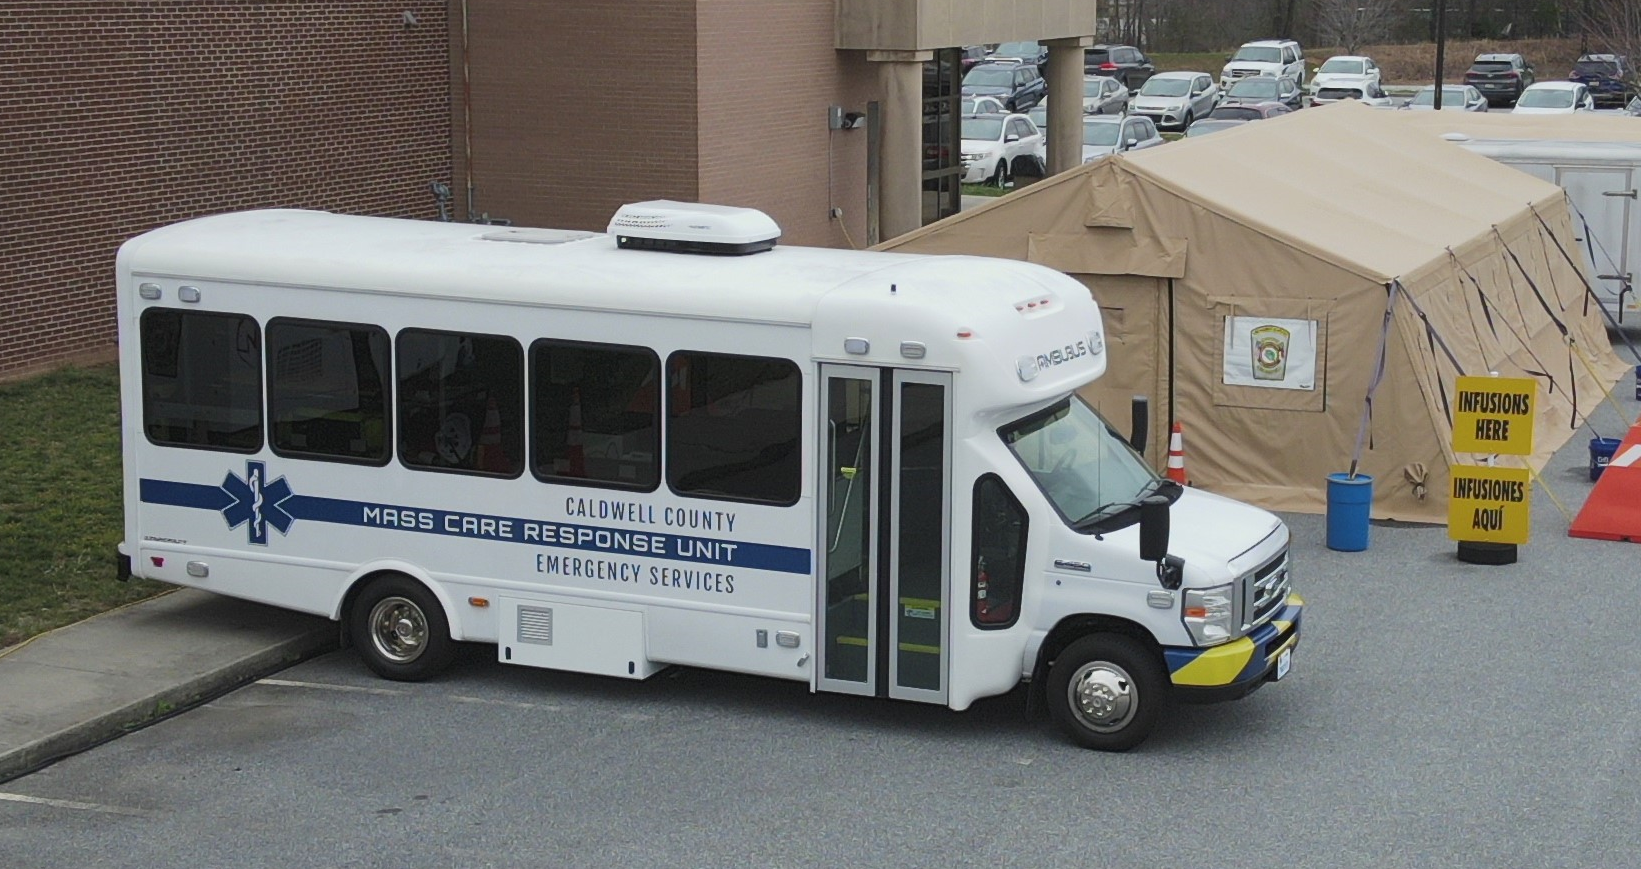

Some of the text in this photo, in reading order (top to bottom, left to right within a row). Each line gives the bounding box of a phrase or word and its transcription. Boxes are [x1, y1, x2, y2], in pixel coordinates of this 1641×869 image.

[1458, 391, 1530, 415] INFUSIONS
[1475, 419, 1510, 441] HERE
[1453, 477, 1524, 503] INFUSIONES
[565, 497, 736, 532] CALDWELL COUNTY
[1472, 505, 1504, 532] AQUÍ
[363, 506, 738, 562] MASS CARE RESPONSE UNIT
[536, 553, 735, 594] EMERGENCY SERVICES
